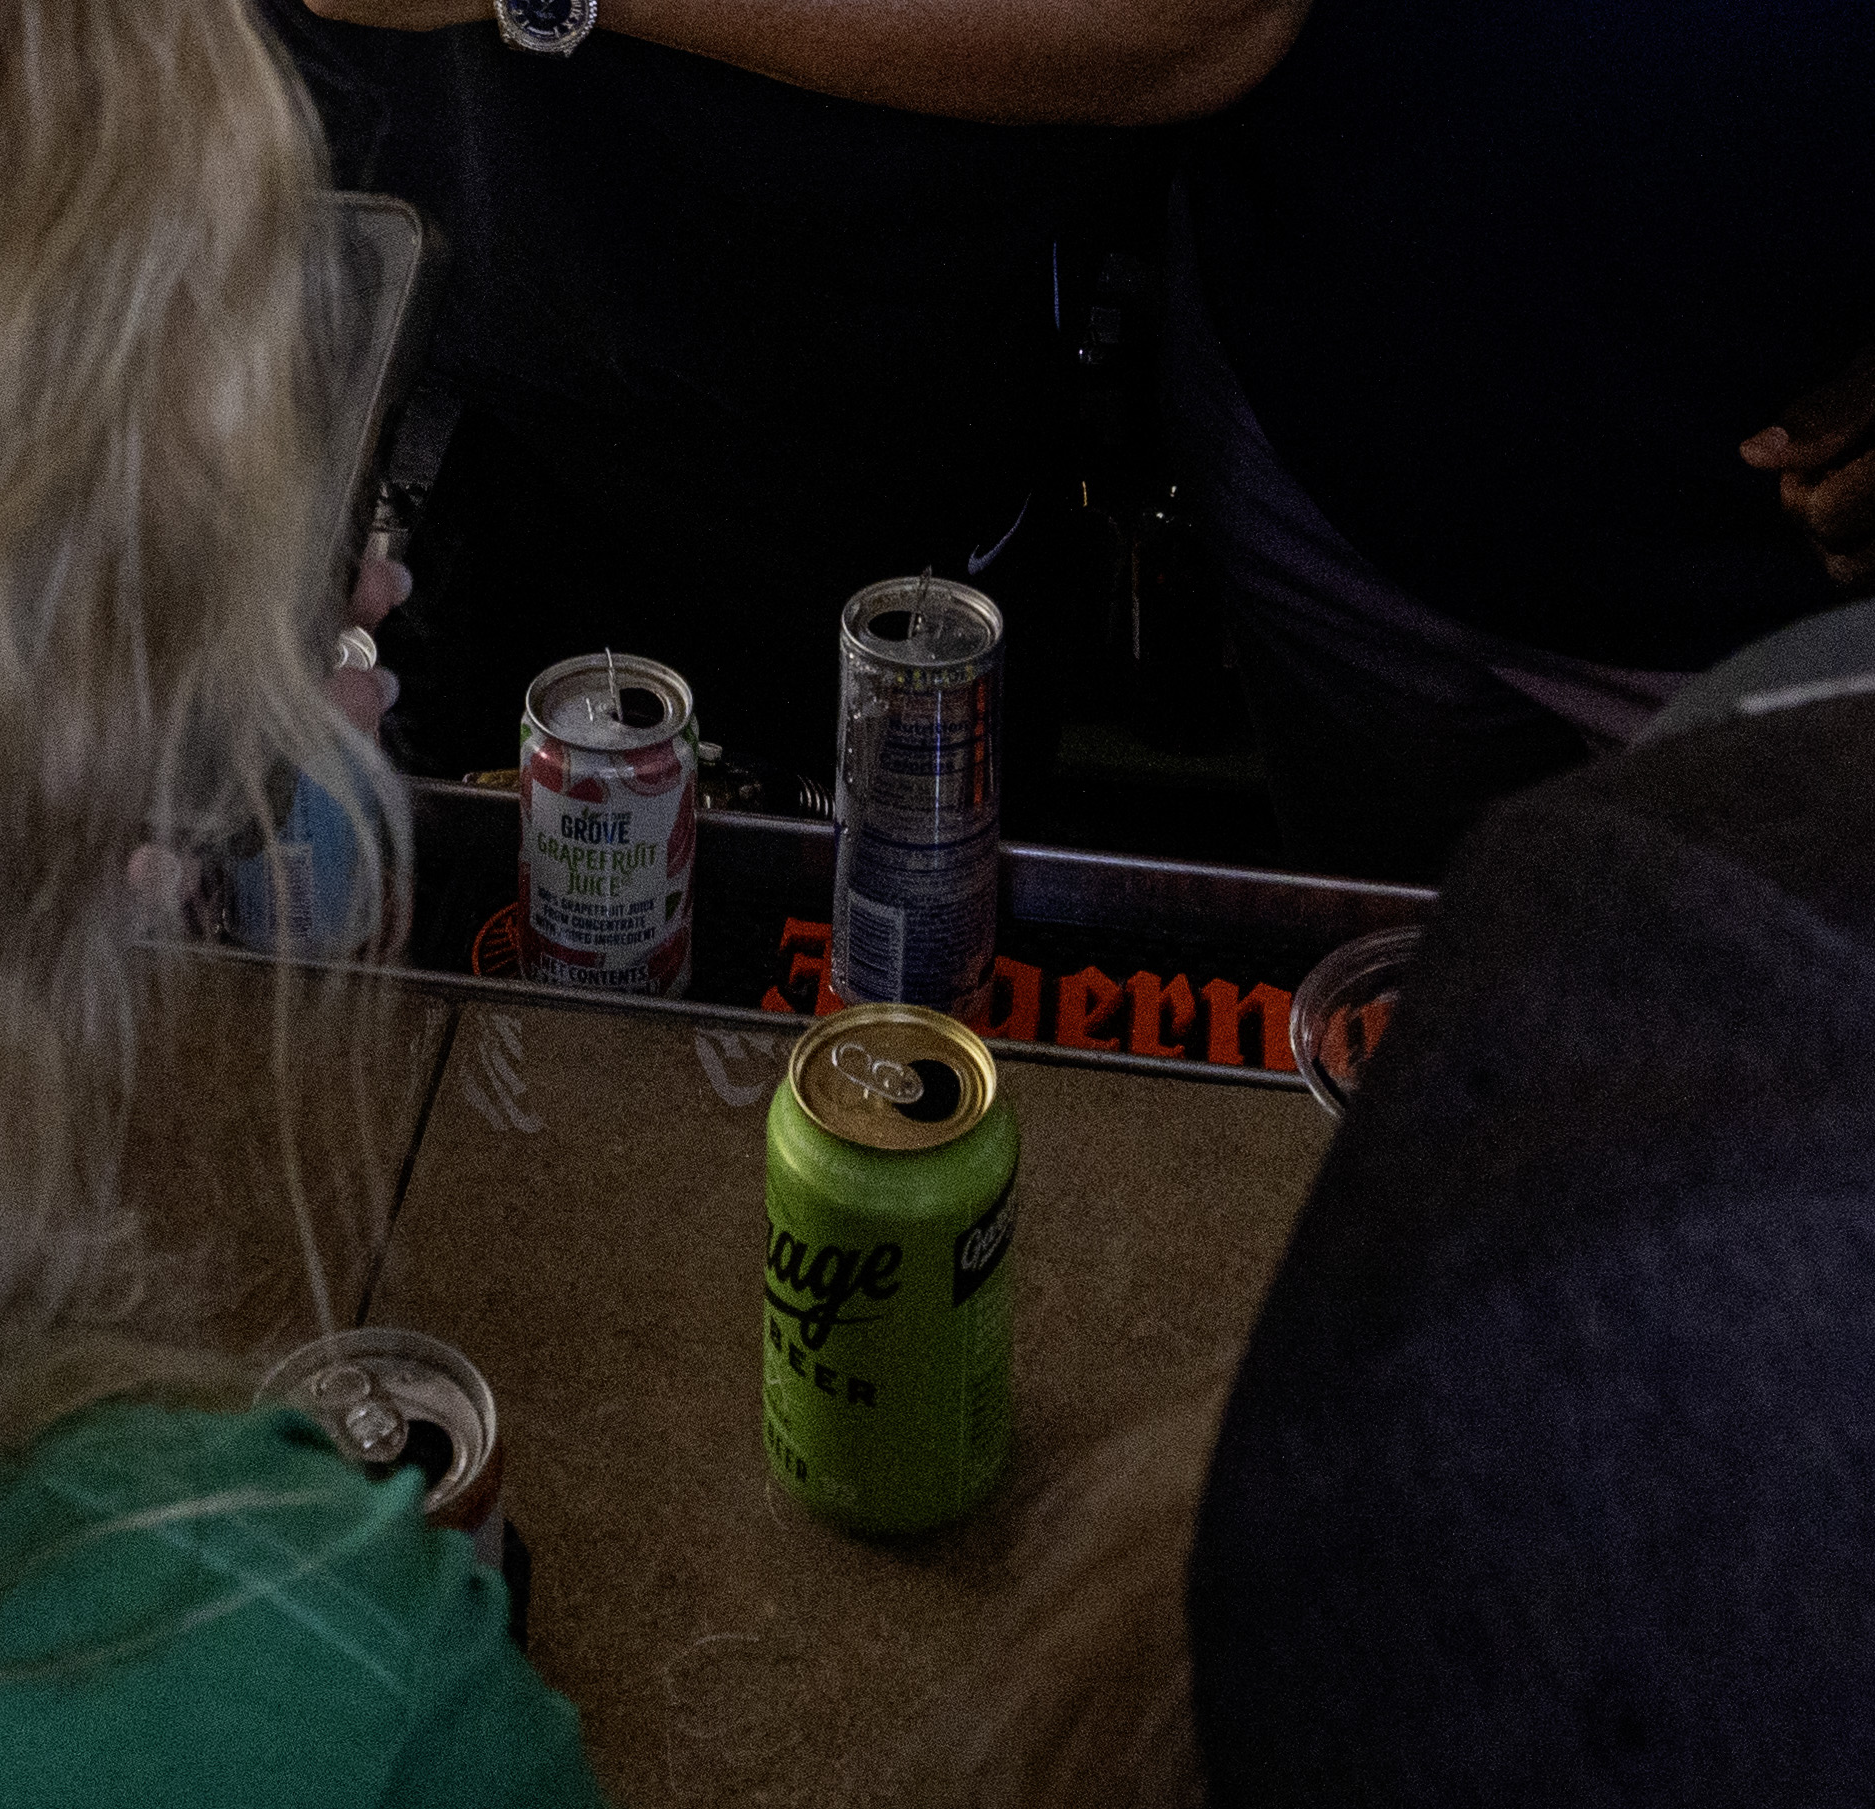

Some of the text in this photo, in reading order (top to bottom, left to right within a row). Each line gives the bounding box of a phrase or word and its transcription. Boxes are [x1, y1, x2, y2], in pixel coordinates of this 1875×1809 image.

[561, 814, 630, 845] GROVE
[537, 830, 658, 876] GRAPEFRUIT
[566, 873, 621, 898] JUICE
[543, 904, 646, 932] FROM CONCENTRATE
[561, 897, 625, 916] GRAPEFRUIT
[628, 897, 656, 916] JUICE
[535, 913, 556, 936] WITH
[540, 952, 648, 986] NET CONTENTS
[769, 1316, 877, 1409] BEER
